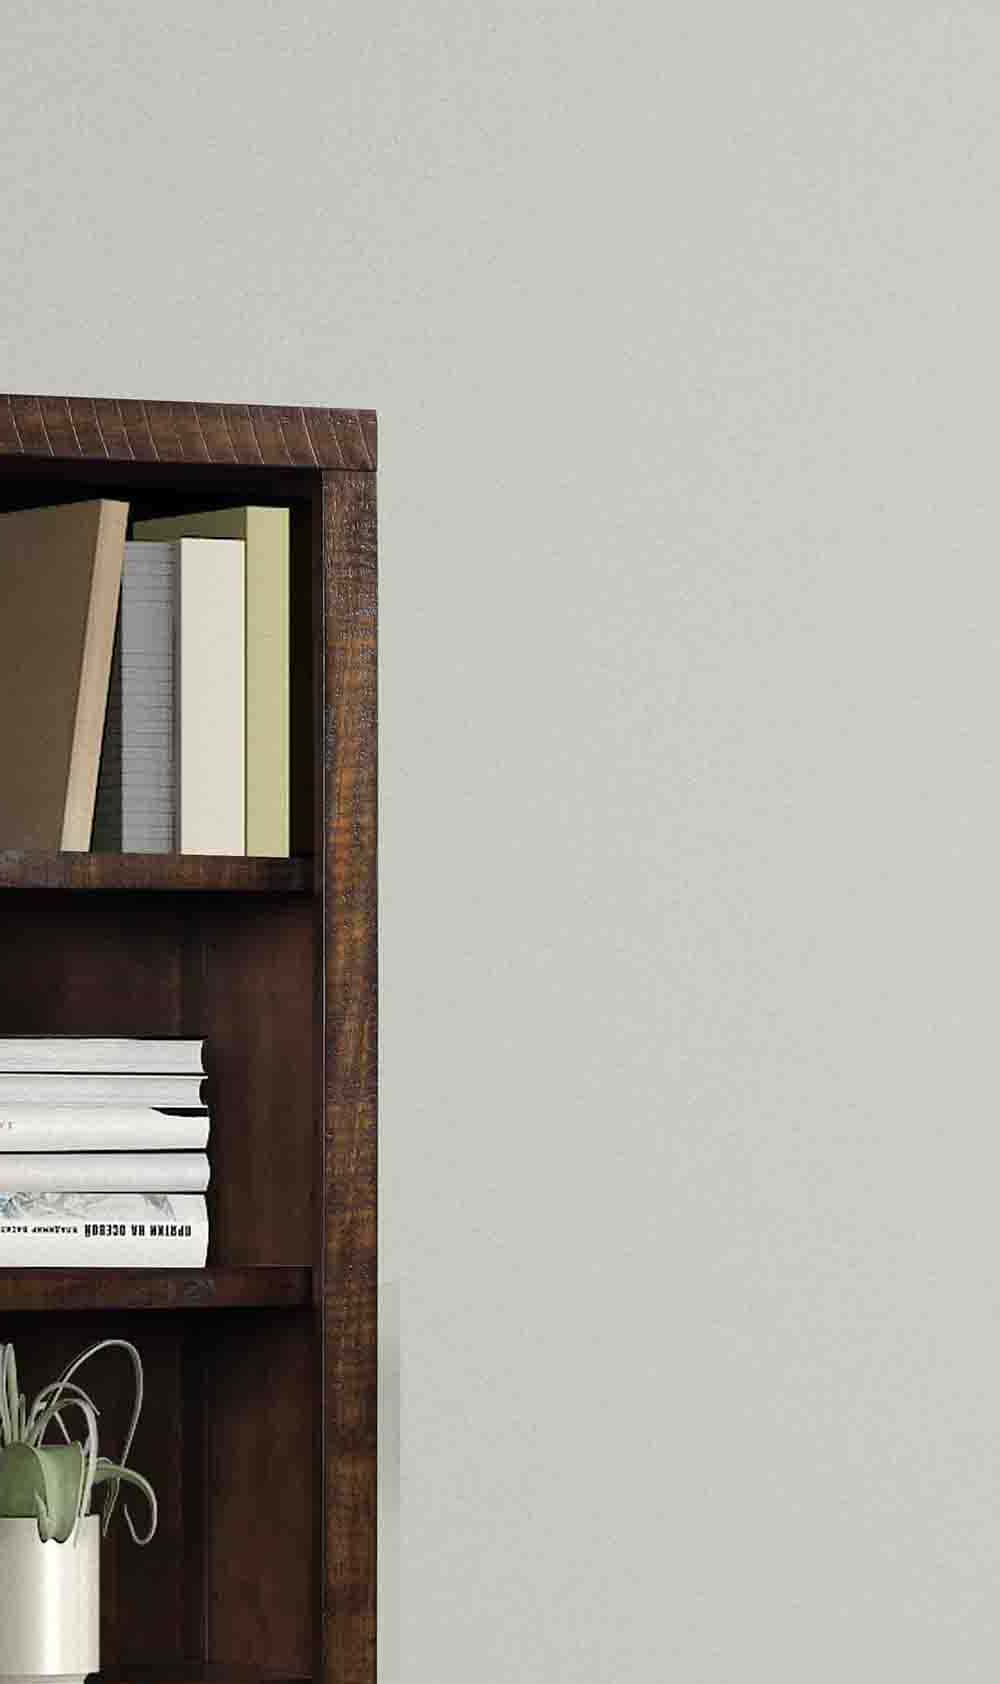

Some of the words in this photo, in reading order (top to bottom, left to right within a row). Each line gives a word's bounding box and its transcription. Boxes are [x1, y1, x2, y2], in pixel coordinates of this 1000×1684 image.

[84, 1224, 126, 1238] ОСЕВОЙ
[131, 1224, 145, 1237] НА
[149, 1224, 192, 1237] ПРЯТКИ
